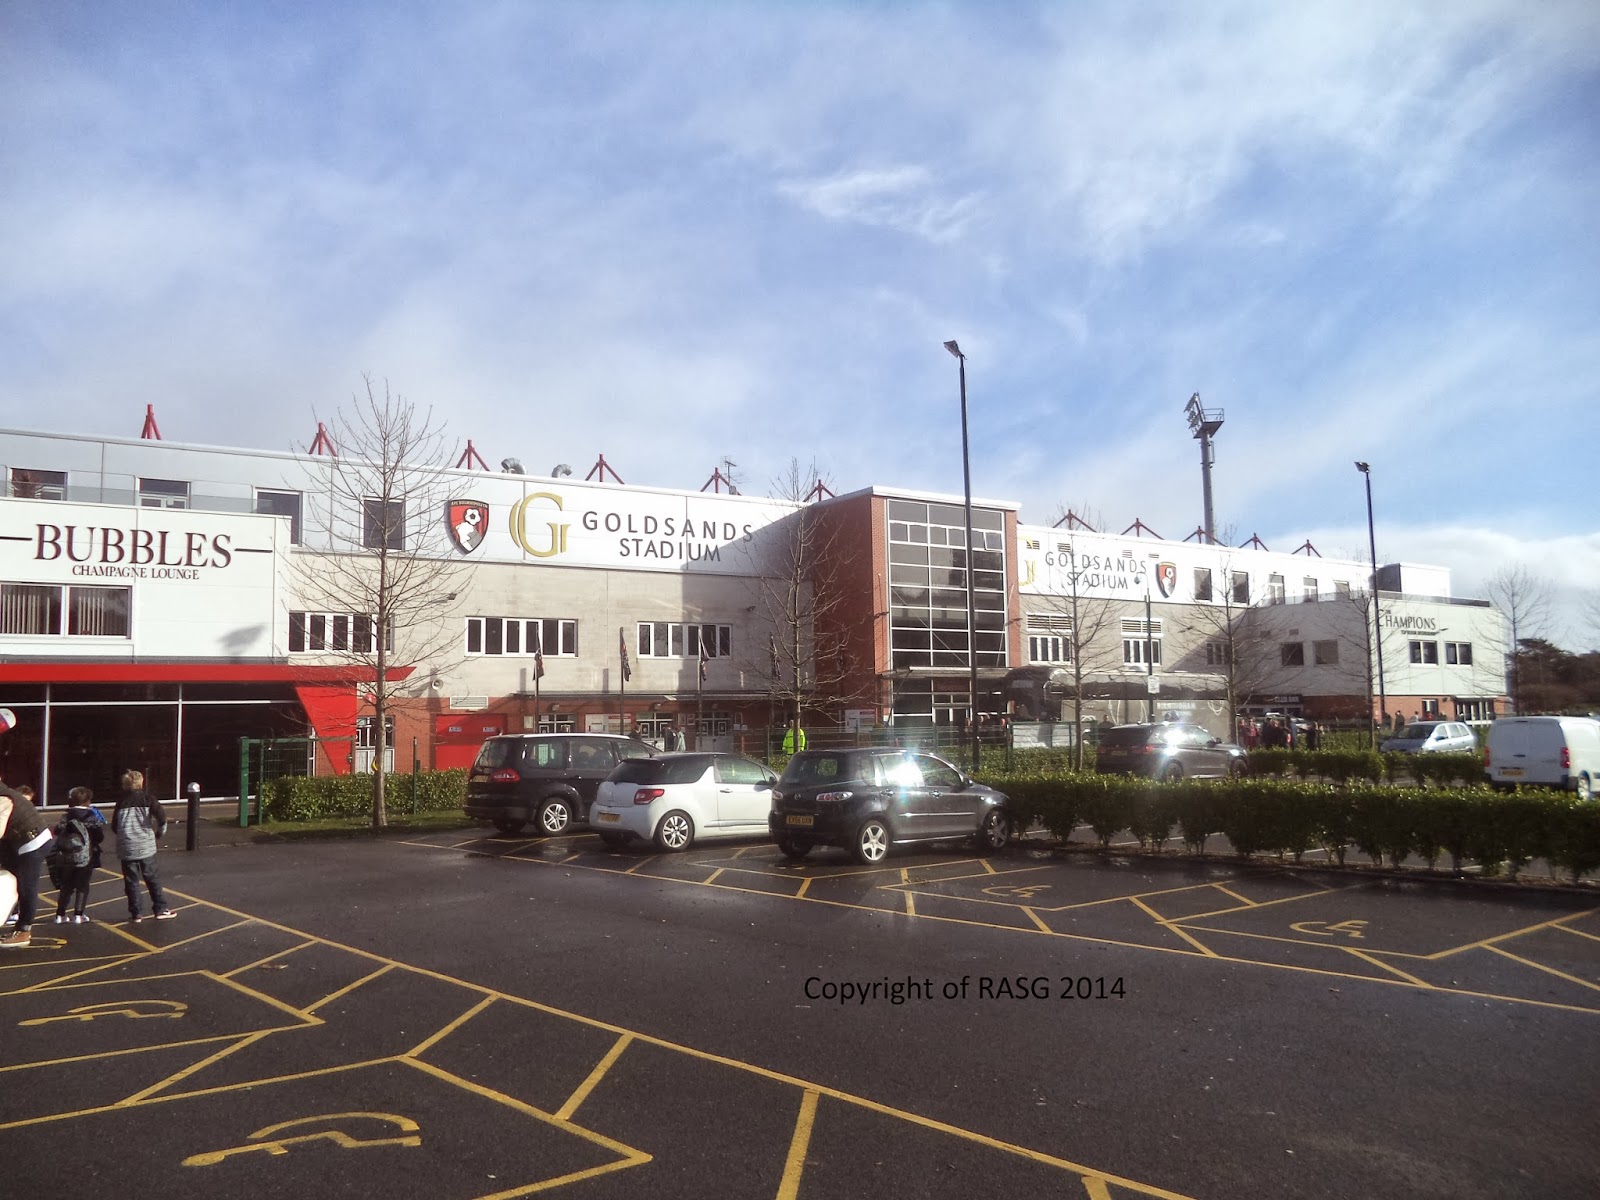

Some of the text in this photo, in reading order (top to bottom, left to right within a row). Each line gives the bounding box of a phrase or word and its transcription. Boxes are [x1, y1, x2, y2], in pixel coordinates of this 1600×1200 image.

[582, 511, 752, 543] GOLDSANDS
[34, 523, 232, 569] BUBBLES
[619, 538, 721, 562] STADIUM
[72, 564, 200, 580] CHAMPAGNE LOUNGE
[1045, 551, 1147, 573] GOLDSANDS
[1067, 571, 1129, 590] STADIUM
